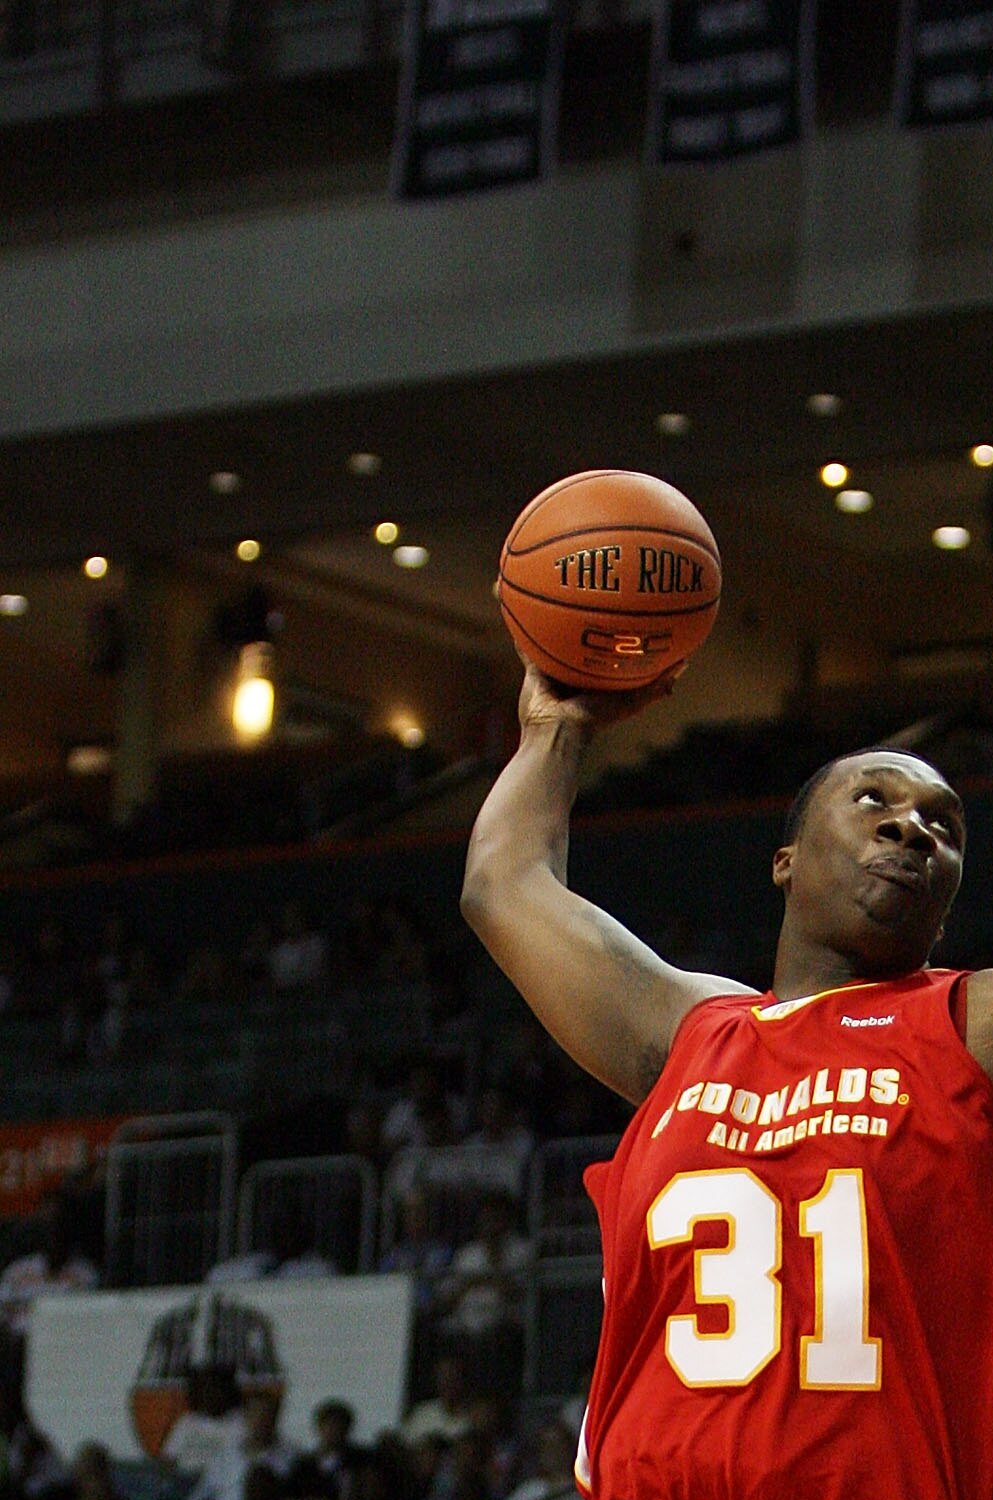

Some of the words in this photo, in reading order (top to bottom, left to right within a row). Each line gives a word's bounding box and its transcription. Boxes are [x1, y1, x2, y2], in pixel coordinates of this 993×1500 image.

[554, 545, 621, 593] THE
[637, 545, 705, 593] ROCK
[840, 1015, 895, 1028] Reebok
[706, 1121, 749, 1152] All
[753, 1109, 888, 1152] American
[647, 1167, 882, 1391] 31
